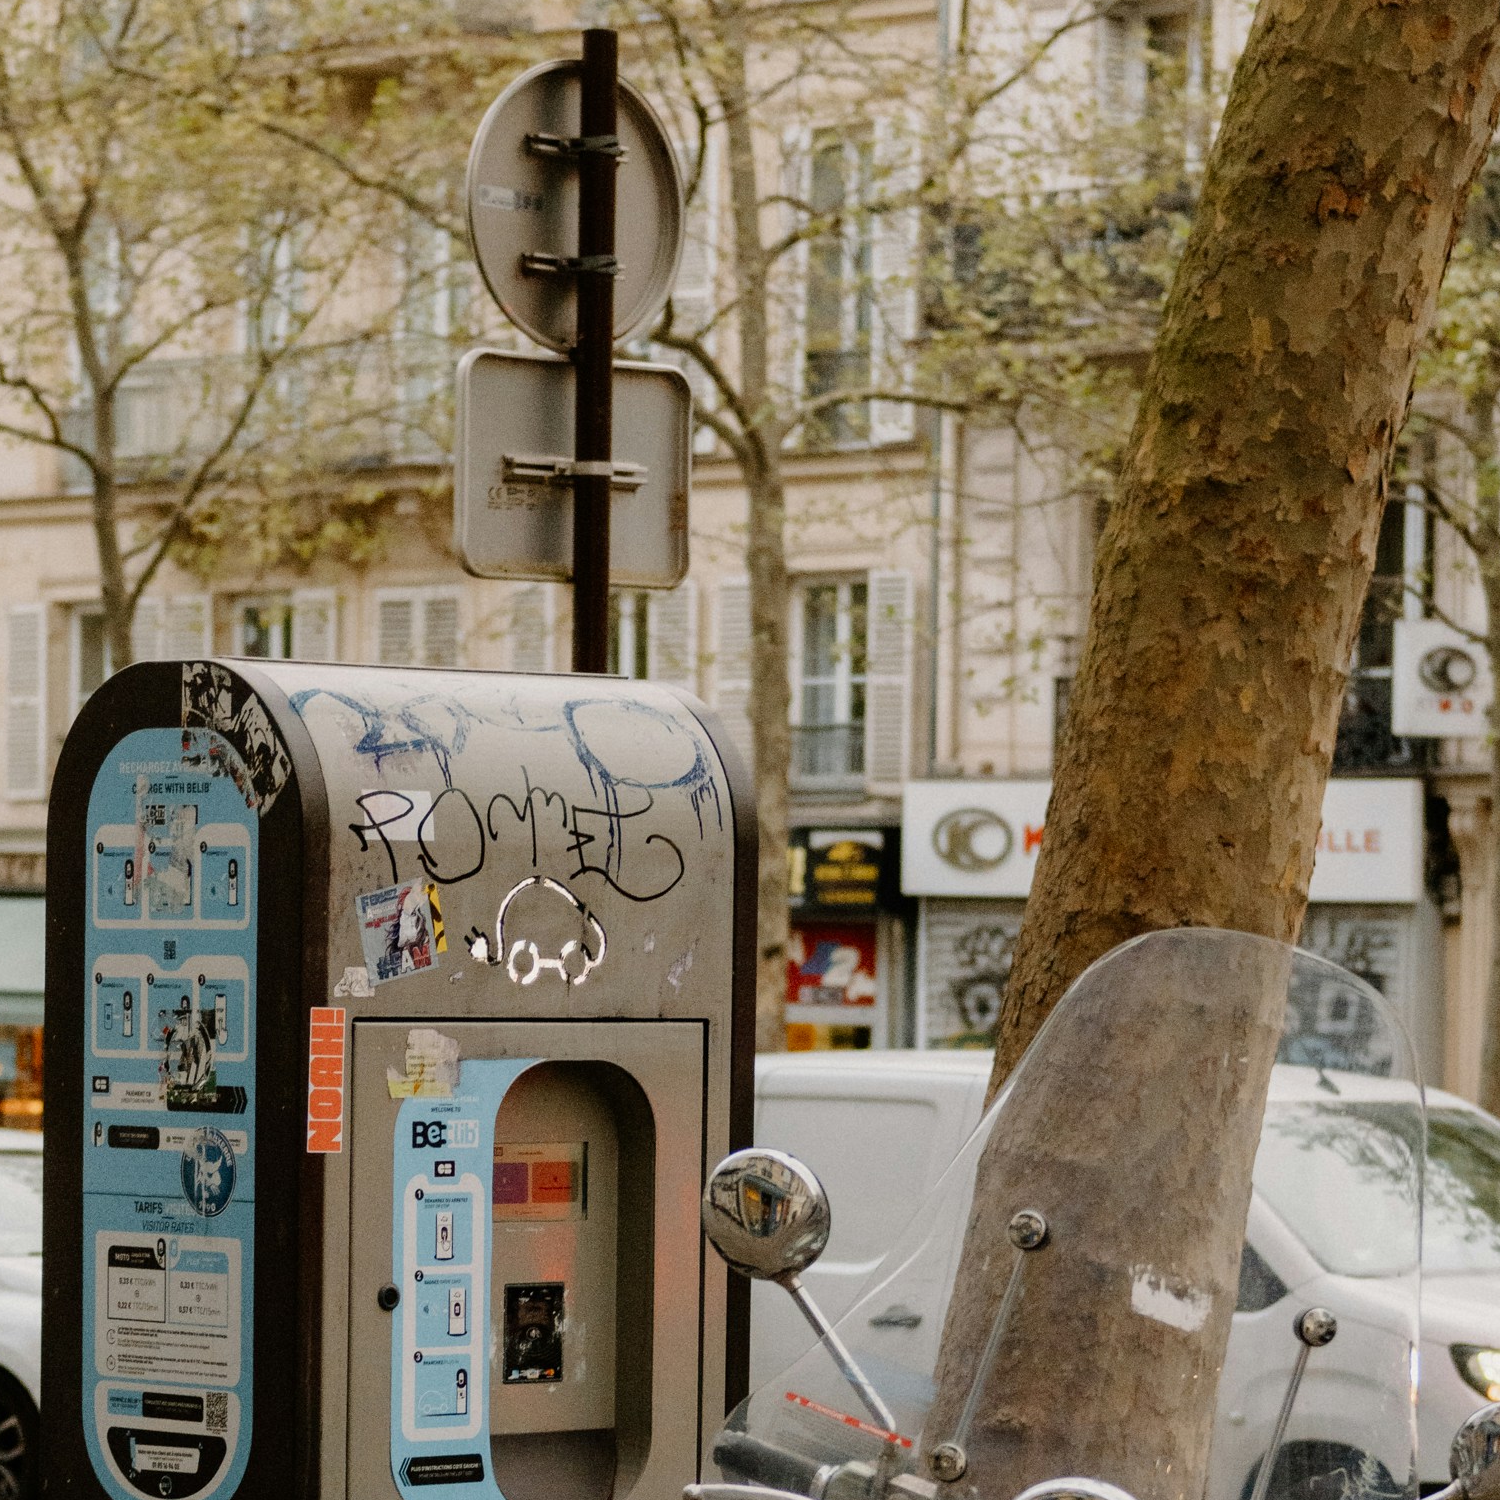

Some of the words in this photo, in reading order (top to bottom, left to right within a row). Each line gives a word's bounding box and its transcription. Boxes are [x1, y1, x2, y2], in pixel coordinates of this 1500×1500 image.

[132, 782, 163, 794] CRGE
[164, 782, 185, 794] WITH
[134, 1201, 163, 1214] TARIFS
